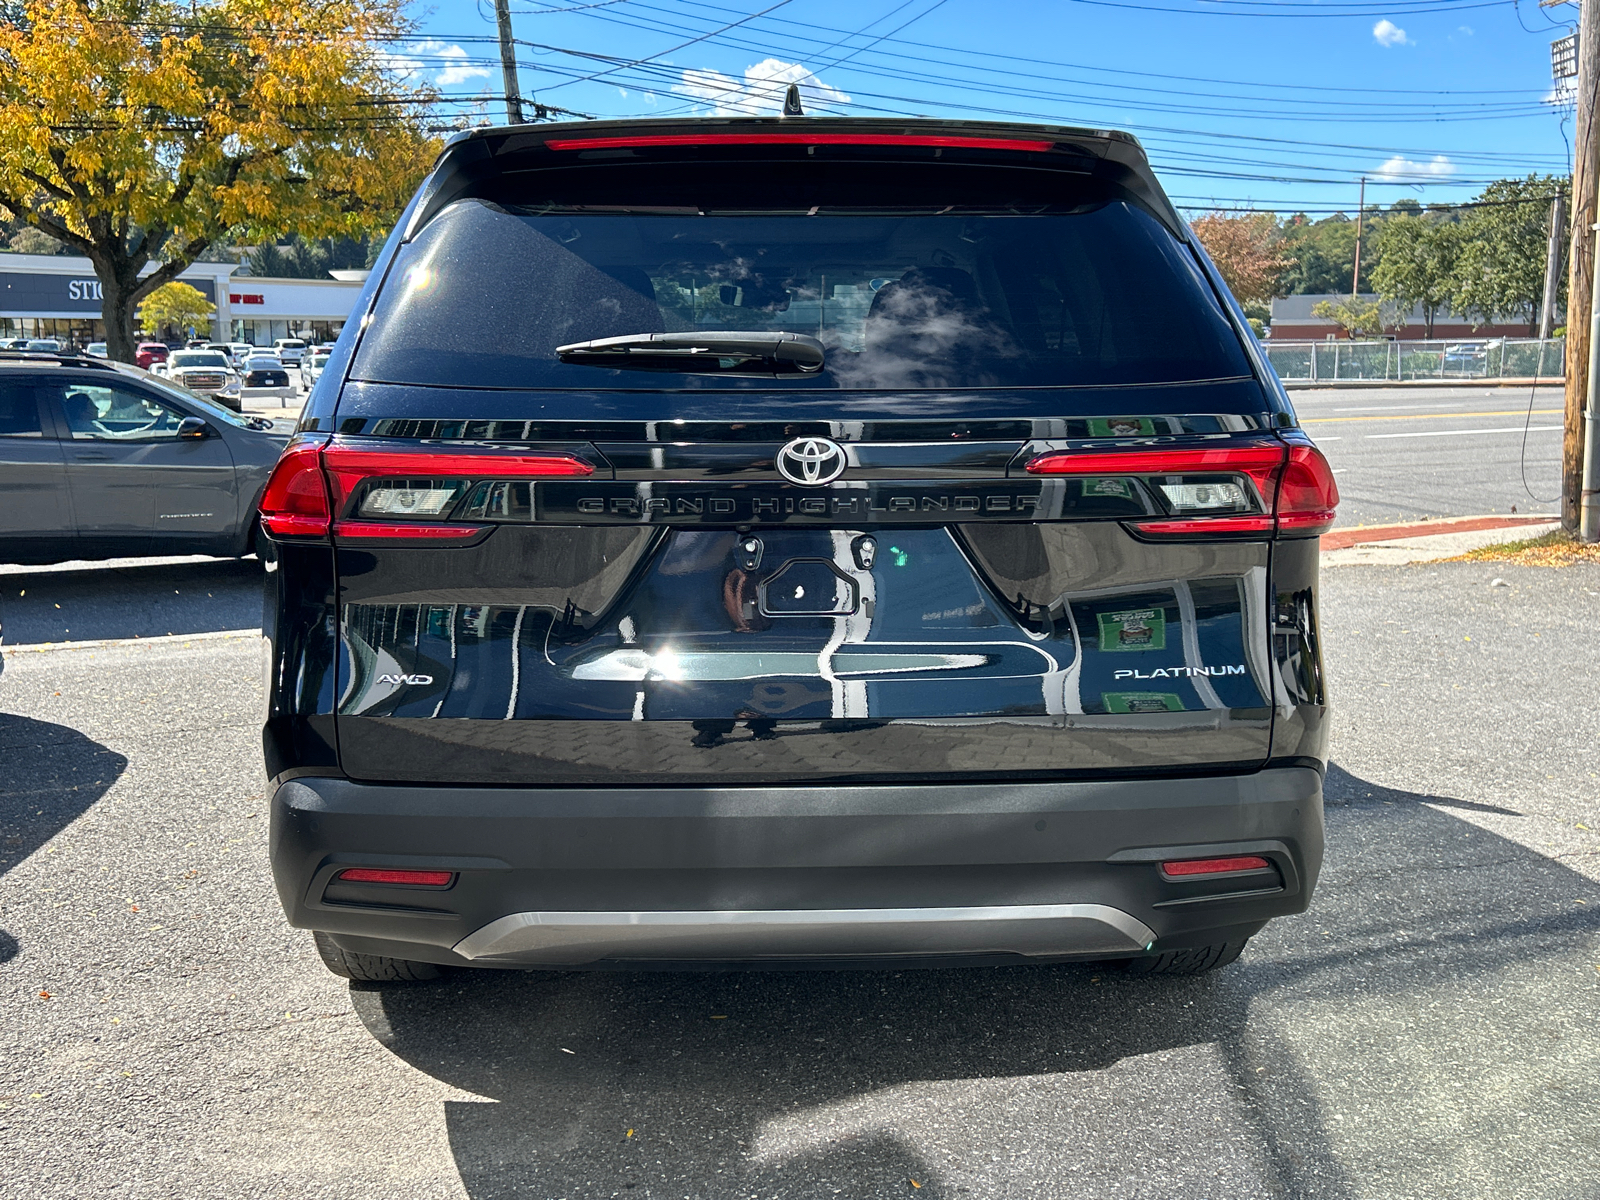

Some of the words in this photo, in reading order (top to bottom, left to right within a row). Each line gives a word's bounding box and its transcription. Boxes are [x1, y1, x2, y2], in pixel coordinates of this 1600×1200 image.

[576, 497, 736, 514] GRAND
[752, 495, 1043, 514] HIGHLANDER
[376, 674, 433, 685] AWD
[1113, 664, 1246, 681] PLATINUM
